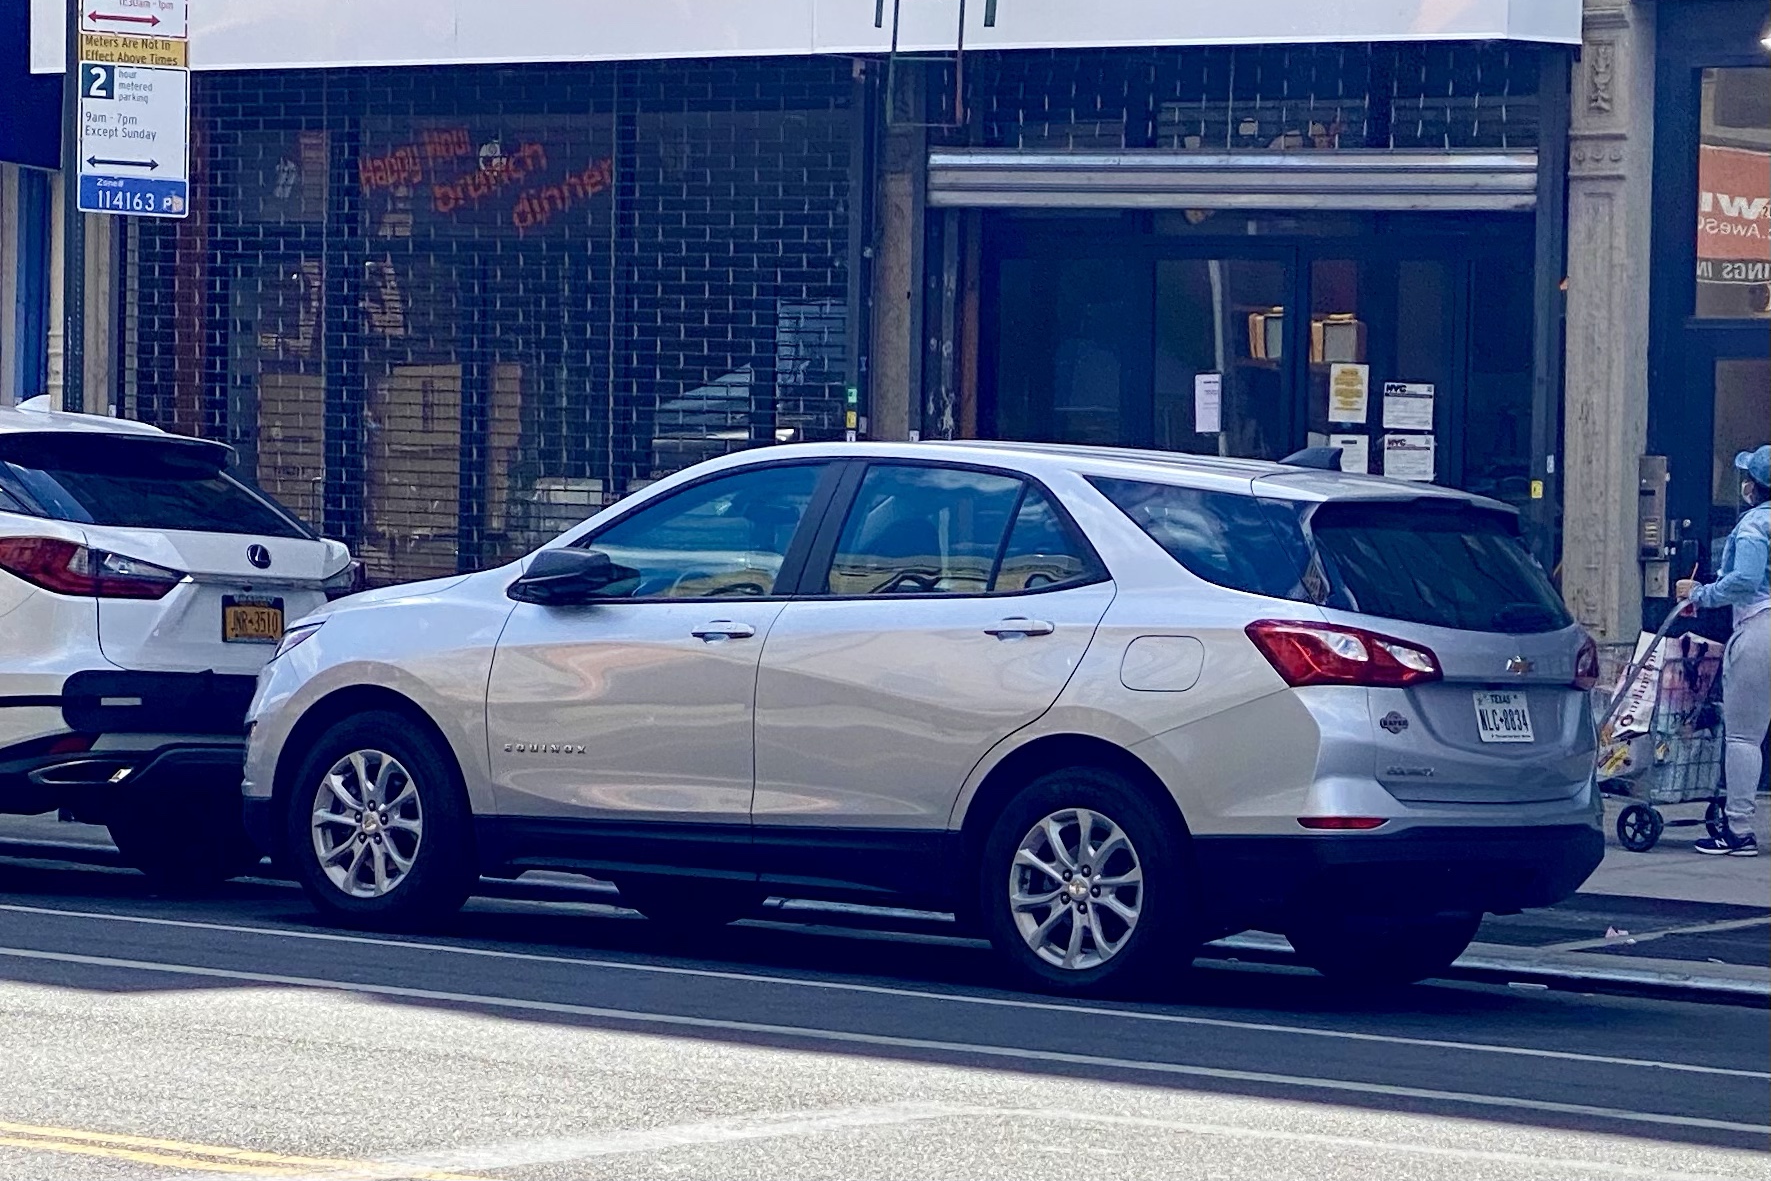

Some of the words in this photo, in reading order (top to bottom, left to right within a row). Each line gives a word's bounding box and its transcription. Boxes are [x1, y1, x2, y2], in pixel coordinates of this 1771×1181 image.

[158, 0, 174, 10] 1pm
[85, 35, 119, 48] Meters
[121, 37, 139, 49] Are
[141, 38, 158, 50] Not
[161, 39, 171, 51] In
[85, 49, 115, 62] Effect
[116, 51, 147, 64] Above
[150, 53, 178, 66] Times
[89, 66, 107, 97] 2
[118, 70, 137, 79] hour
[118, 81, 153, 92] metered
[118, 93, 149, 105] parking
[85, 111, 107, 123] 9am
[117, 113, 138, 126] 7pm
[85, 125, 119, 139] Except
[121, 127, 157, 142] Sunday
[359, 145, 422, 188] Happy
[98, 189, 155, 212] 114163
[503, 743, 587, 754] EQUINOX
